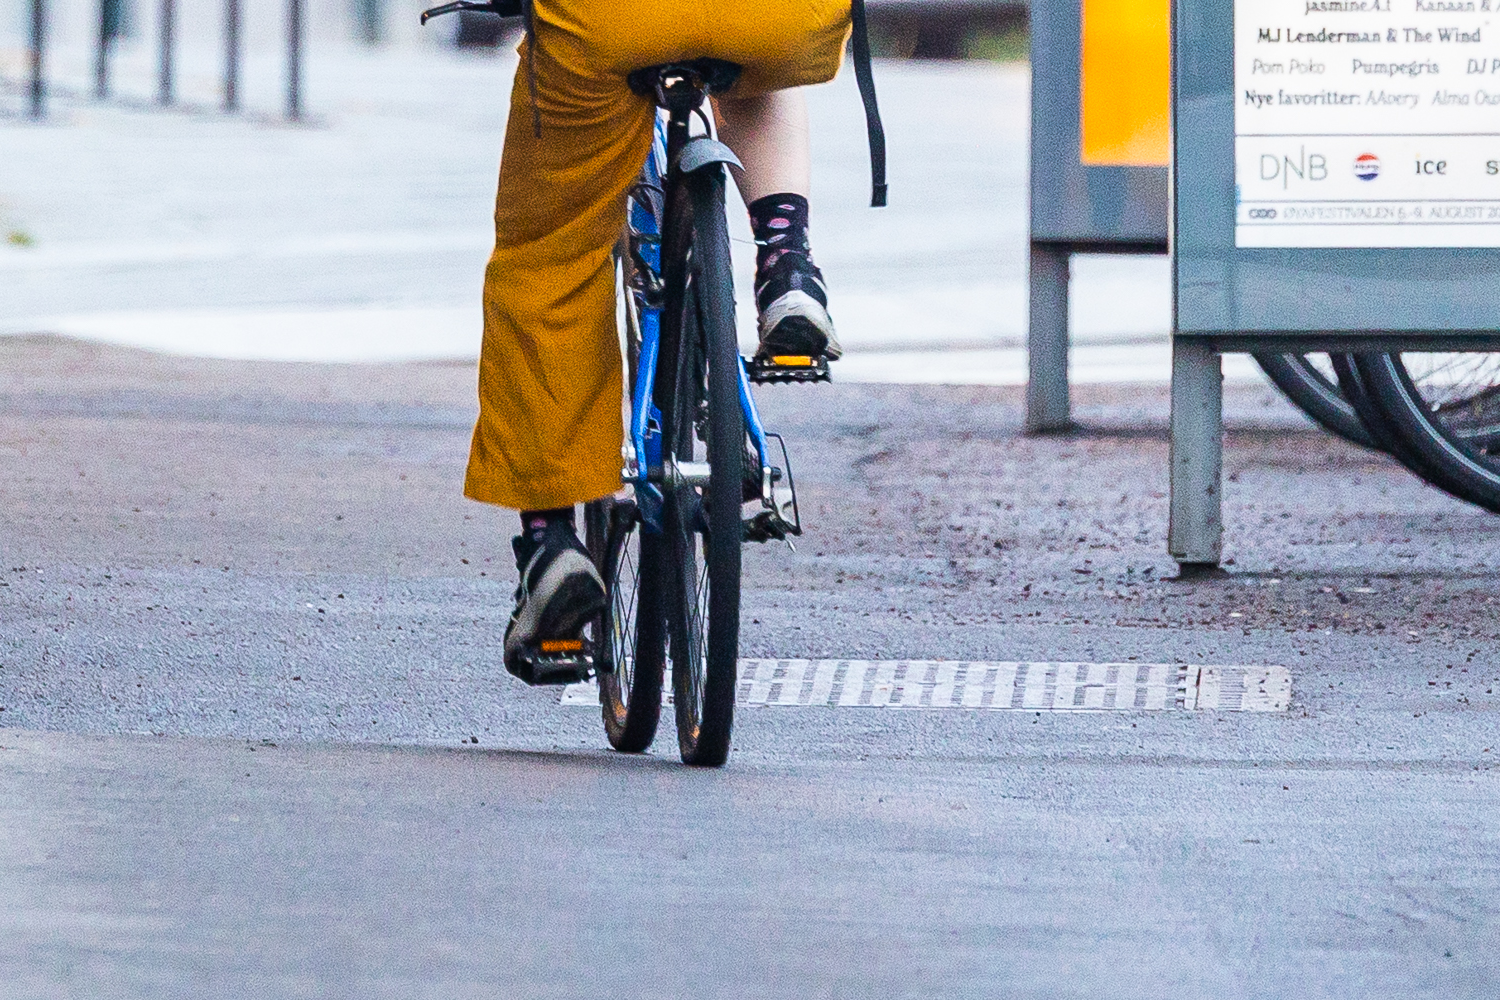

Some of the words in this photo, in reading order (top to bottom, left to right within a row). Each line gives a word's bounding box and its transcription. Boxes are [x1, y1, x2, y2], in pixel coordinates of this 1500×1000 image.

[1257, 27, 1281, 44] MJ
[1286, 27, 1381, 44] Lenderman
[1385, 27, 1397, 43] &
[1402, 26, 1433, 44] The
[1437, 27, 1482, 44] Wind
[1251, 57, 1285, 76] Pom
[1288, 57, 1326, 75] Poko
[1351, 57, 1440, 78] Pumpegris
[1465, 57, 1488, 75] DJ
[1244, 89, 1274, 110] Nye
[1277, 88, 1361, 106] favoritter:
[1259, 144, 1329, 191] DNB
[1415, 153, 1448, 175] ice
